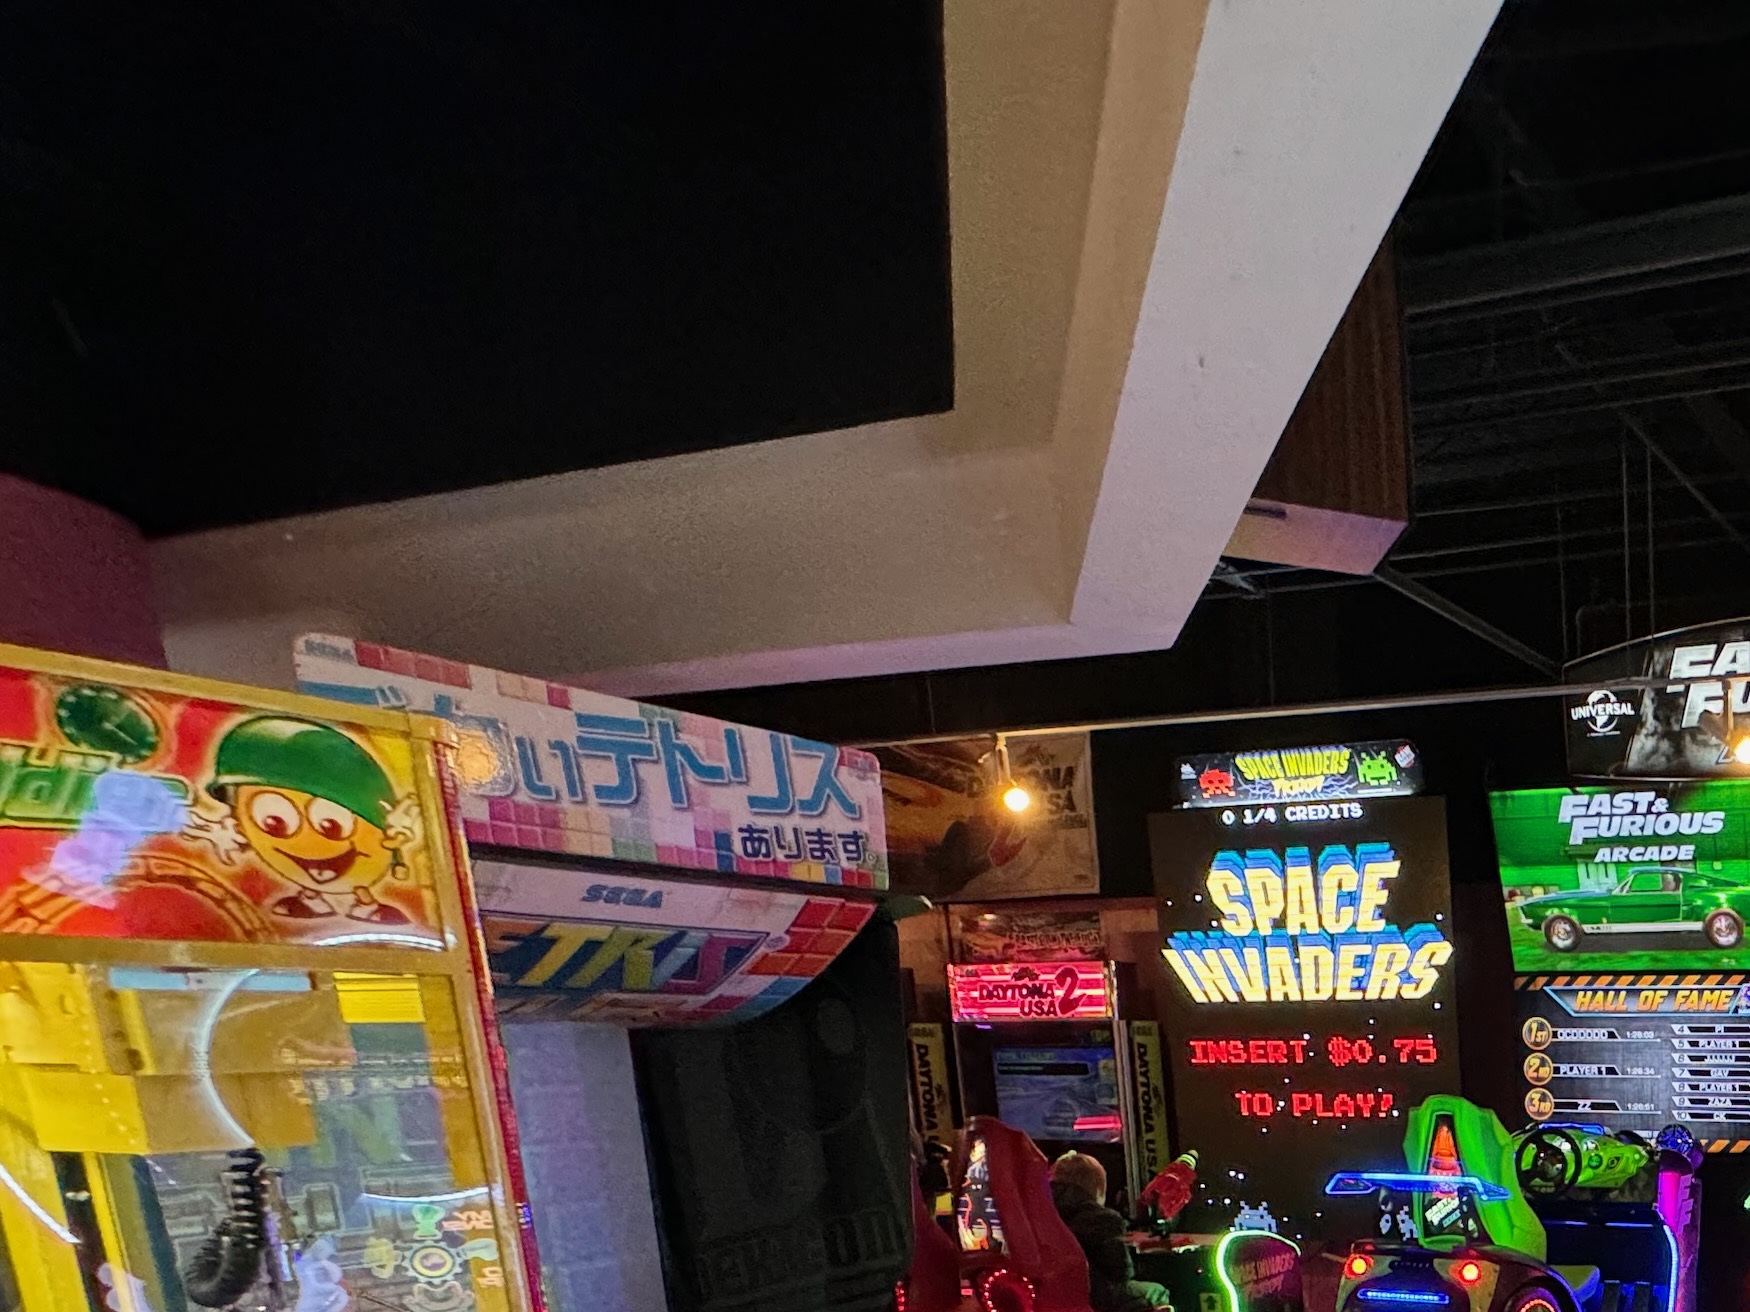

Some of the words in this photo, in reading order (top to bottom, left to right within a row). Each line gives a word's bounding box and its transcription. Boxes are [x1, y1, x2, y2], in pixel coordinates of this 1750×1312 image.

[1570, 701, 1636, 722] UNIVERSAL
[1235, 752, 1284, 780] SPACE
[1281, 748, 1351, 778] INVADERS
[1242, 808, 1278, 825] 1/4
[1284, 802, 1364, 822] CREDITS
[1558, 790, 1656, 823] FAST
[1569, 811, 1726, 846] FURIOUS
[1594, 844, 1696, 863] ARCADE
[582, 883, 663, 909] SEGA
[1206, 852, 1401, 937] SPACE
[1161, 932, 1454, 1003] INVADERS
[978, 982, 1056, 1001] DAYTONA
[1054, 965, 1089, 1016] 2
[1574, 990, 1628, 1011] HALL
[1636, 990, 1669, 1010] OF
[1673, 989, 1735, 1010] FAME
[1019, 998, 1058, 1018] USA
[1189, 1039, 1308, 1065] INSERT
[1327, 1036, 1438, 1067] $0.75
[1560, 1066, 1598, 1076] PLAYER
[915, 1043, 939, 1133] DAYTONA
[1136, 1042, 1156, 1135] DAYTONA
[1234, 1091, 1273, 1118] TO
[1291, 1092, 1394, 1118] PLAY!
[1676, 1111, 1688, 1121] 10
